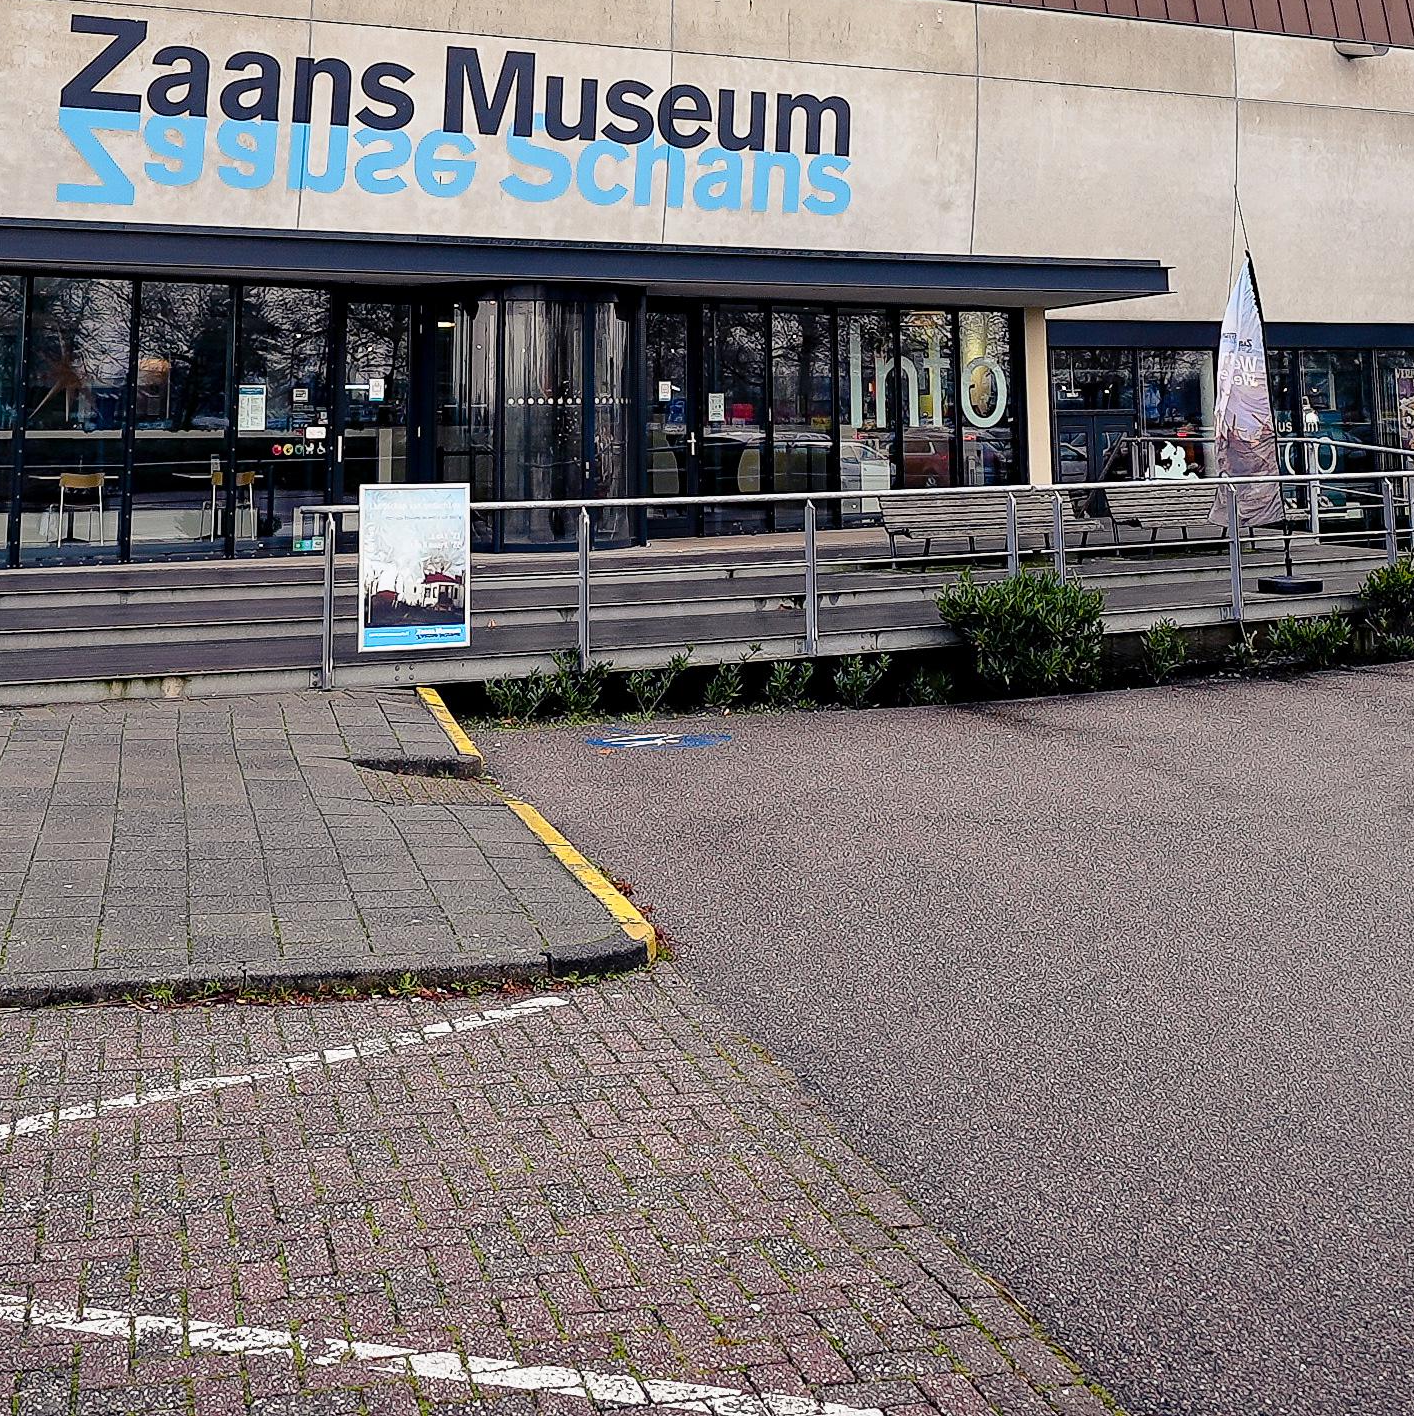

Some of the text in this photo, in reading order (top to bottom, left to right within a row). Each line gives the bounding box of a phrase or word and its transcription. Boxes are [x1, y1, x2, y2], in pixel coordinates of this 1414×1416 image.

[59, 14, 852, 157] Zaans Museum
[499, 113, 852, 216] Schans
[849, 322, 1009, 429] Info
